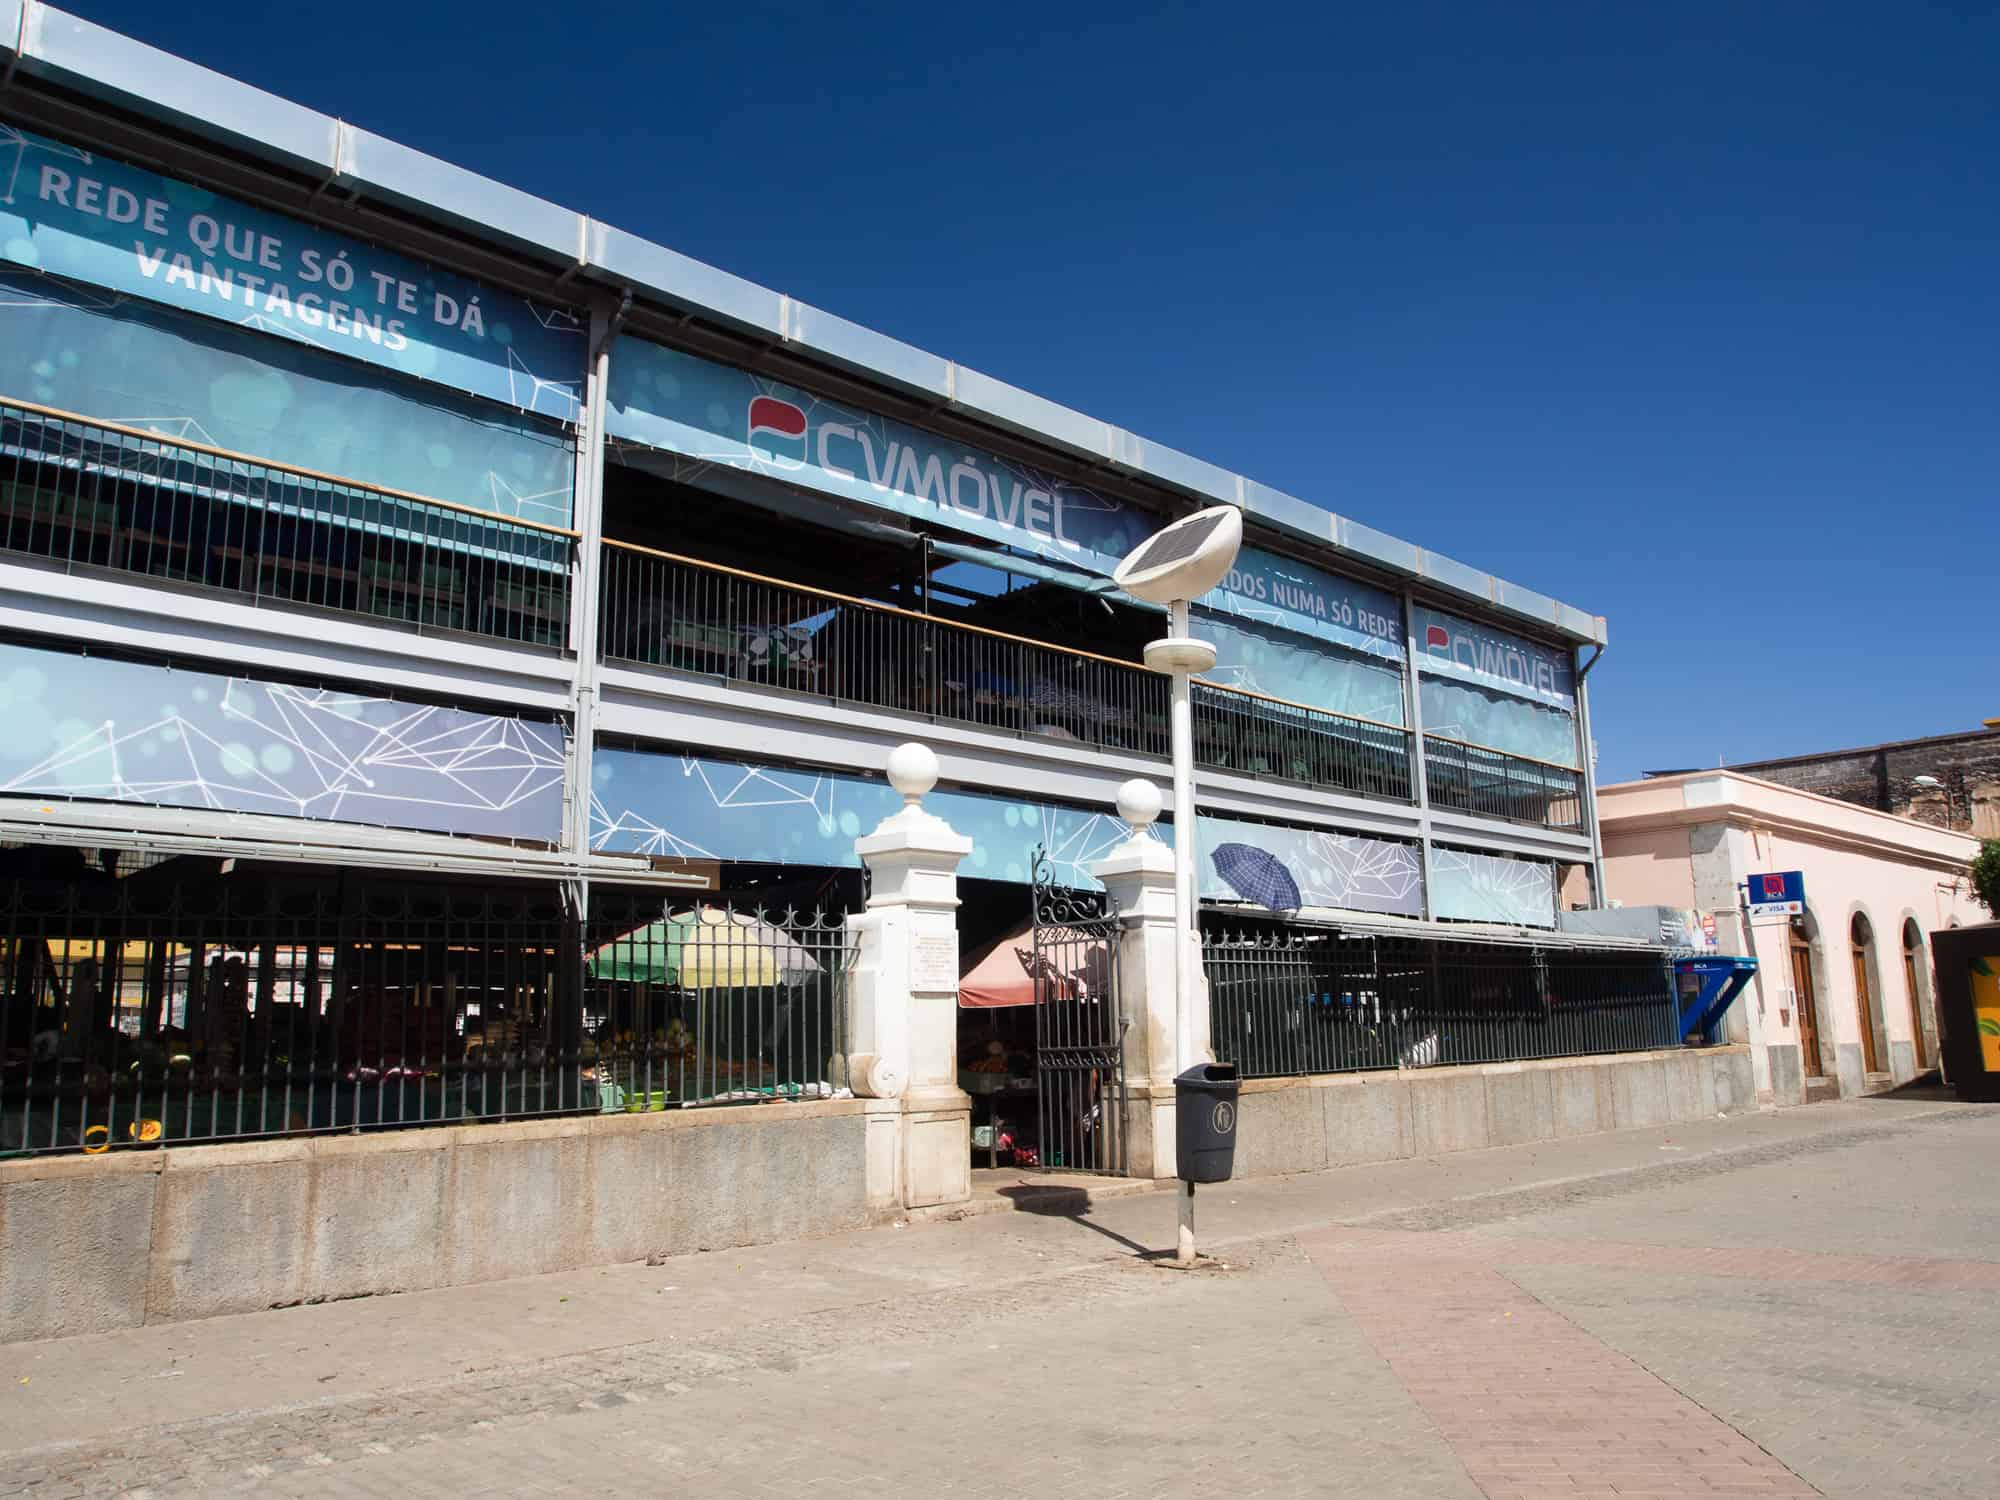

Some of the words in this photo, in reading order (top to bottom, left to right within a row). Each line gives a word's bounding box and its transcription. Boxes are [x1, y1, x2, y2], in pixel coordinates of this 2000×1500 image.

[39, 165, 169, 236] REDE
[188, 214, 282, 271] QUE
[300, 250, 354, 292] SÓ
[371, 271, 417, 315] TE
[434, 293, 485, 337] DÁ
[135, 241, 408, 352] VANTAGENS
[1273, 583, 1326, 619] NUMA
[1331, 597, 1352, 625] SÓ
[1358, 609, 1397, 640] REDE
